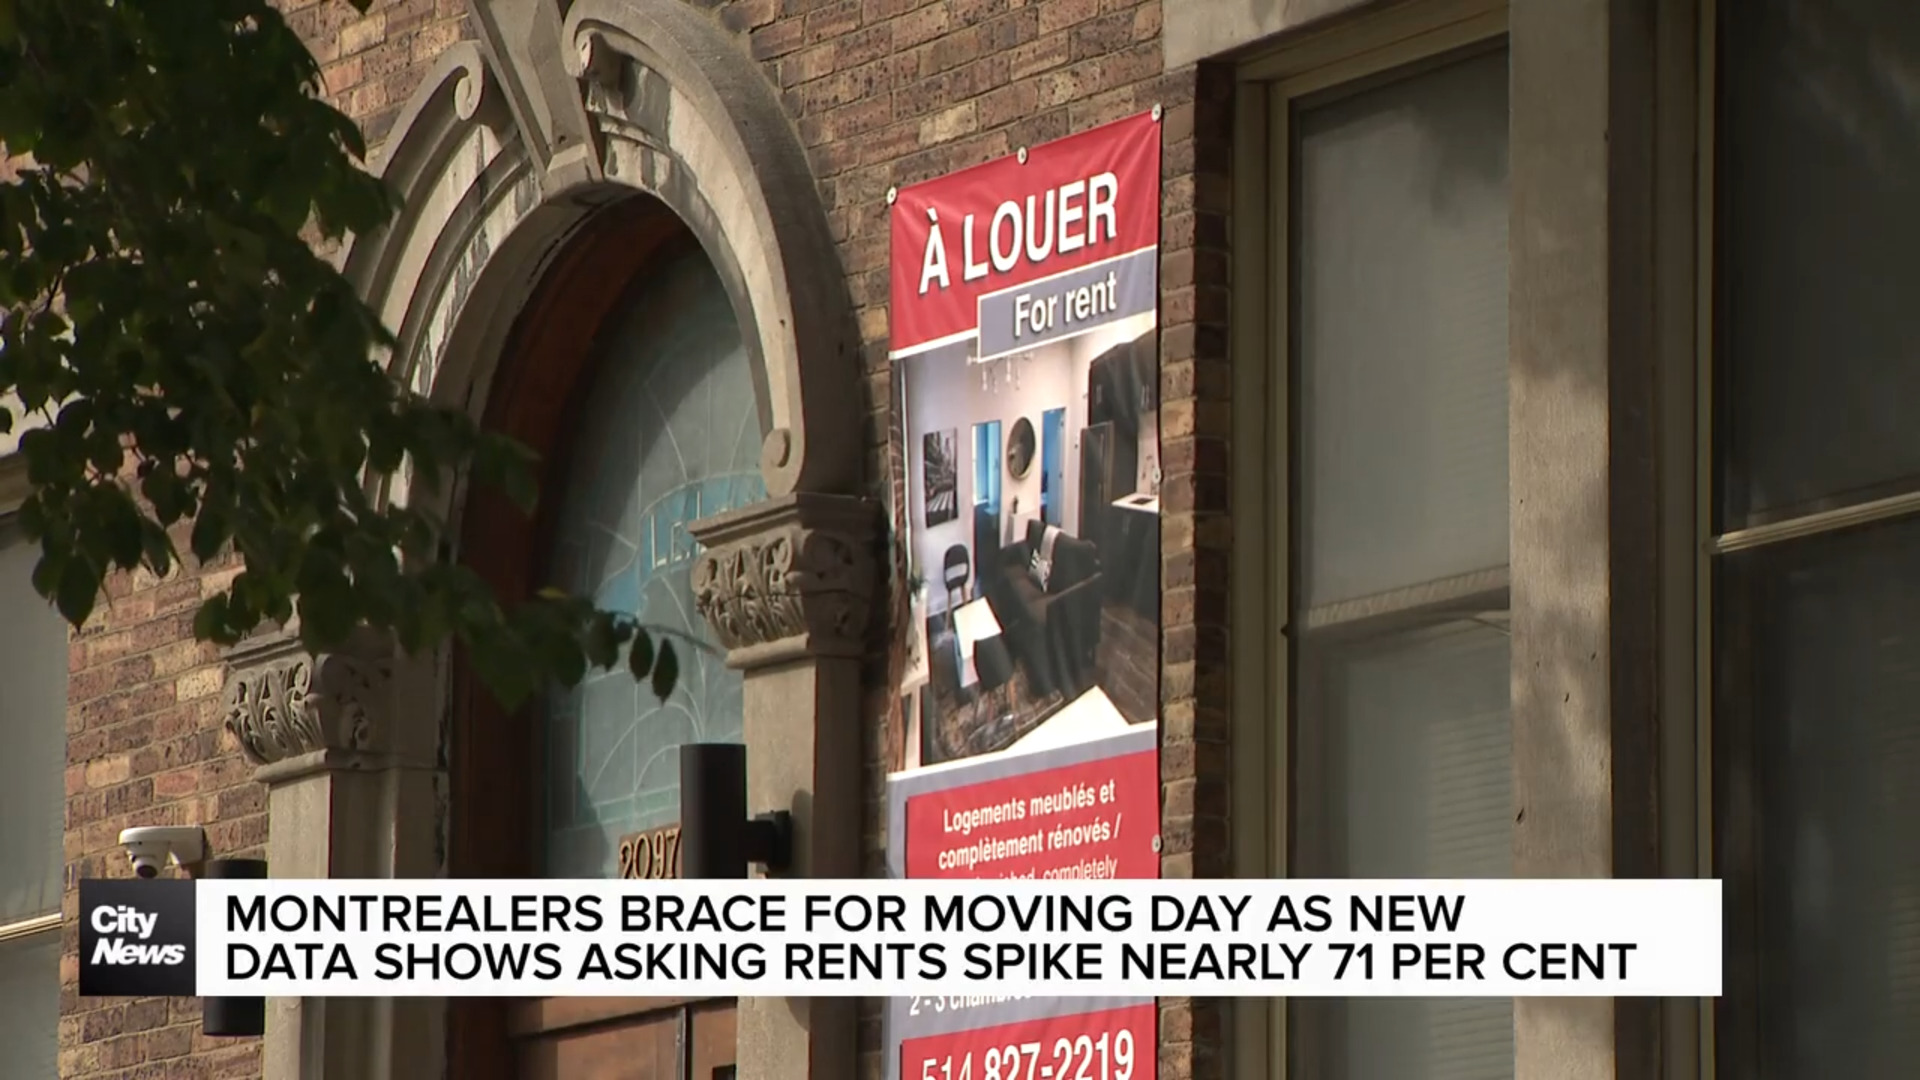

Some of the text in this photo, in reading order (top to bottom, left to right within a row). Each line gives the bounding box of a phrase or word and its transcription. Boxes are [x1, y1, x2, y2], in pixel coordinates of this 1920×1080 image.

[919, 171, 1118, 294] À LOUER
[1014, 271, 1117, 337] For rent
[943, 779, 1115, 835] Logements meublés et
[619, 827, 681, 879] 2097
[938, 813, 1122, 870] complètement rénovés /
[1043, 855, 1117, 878] completely
[985, 1029, 1134, 1080] 827-2219
